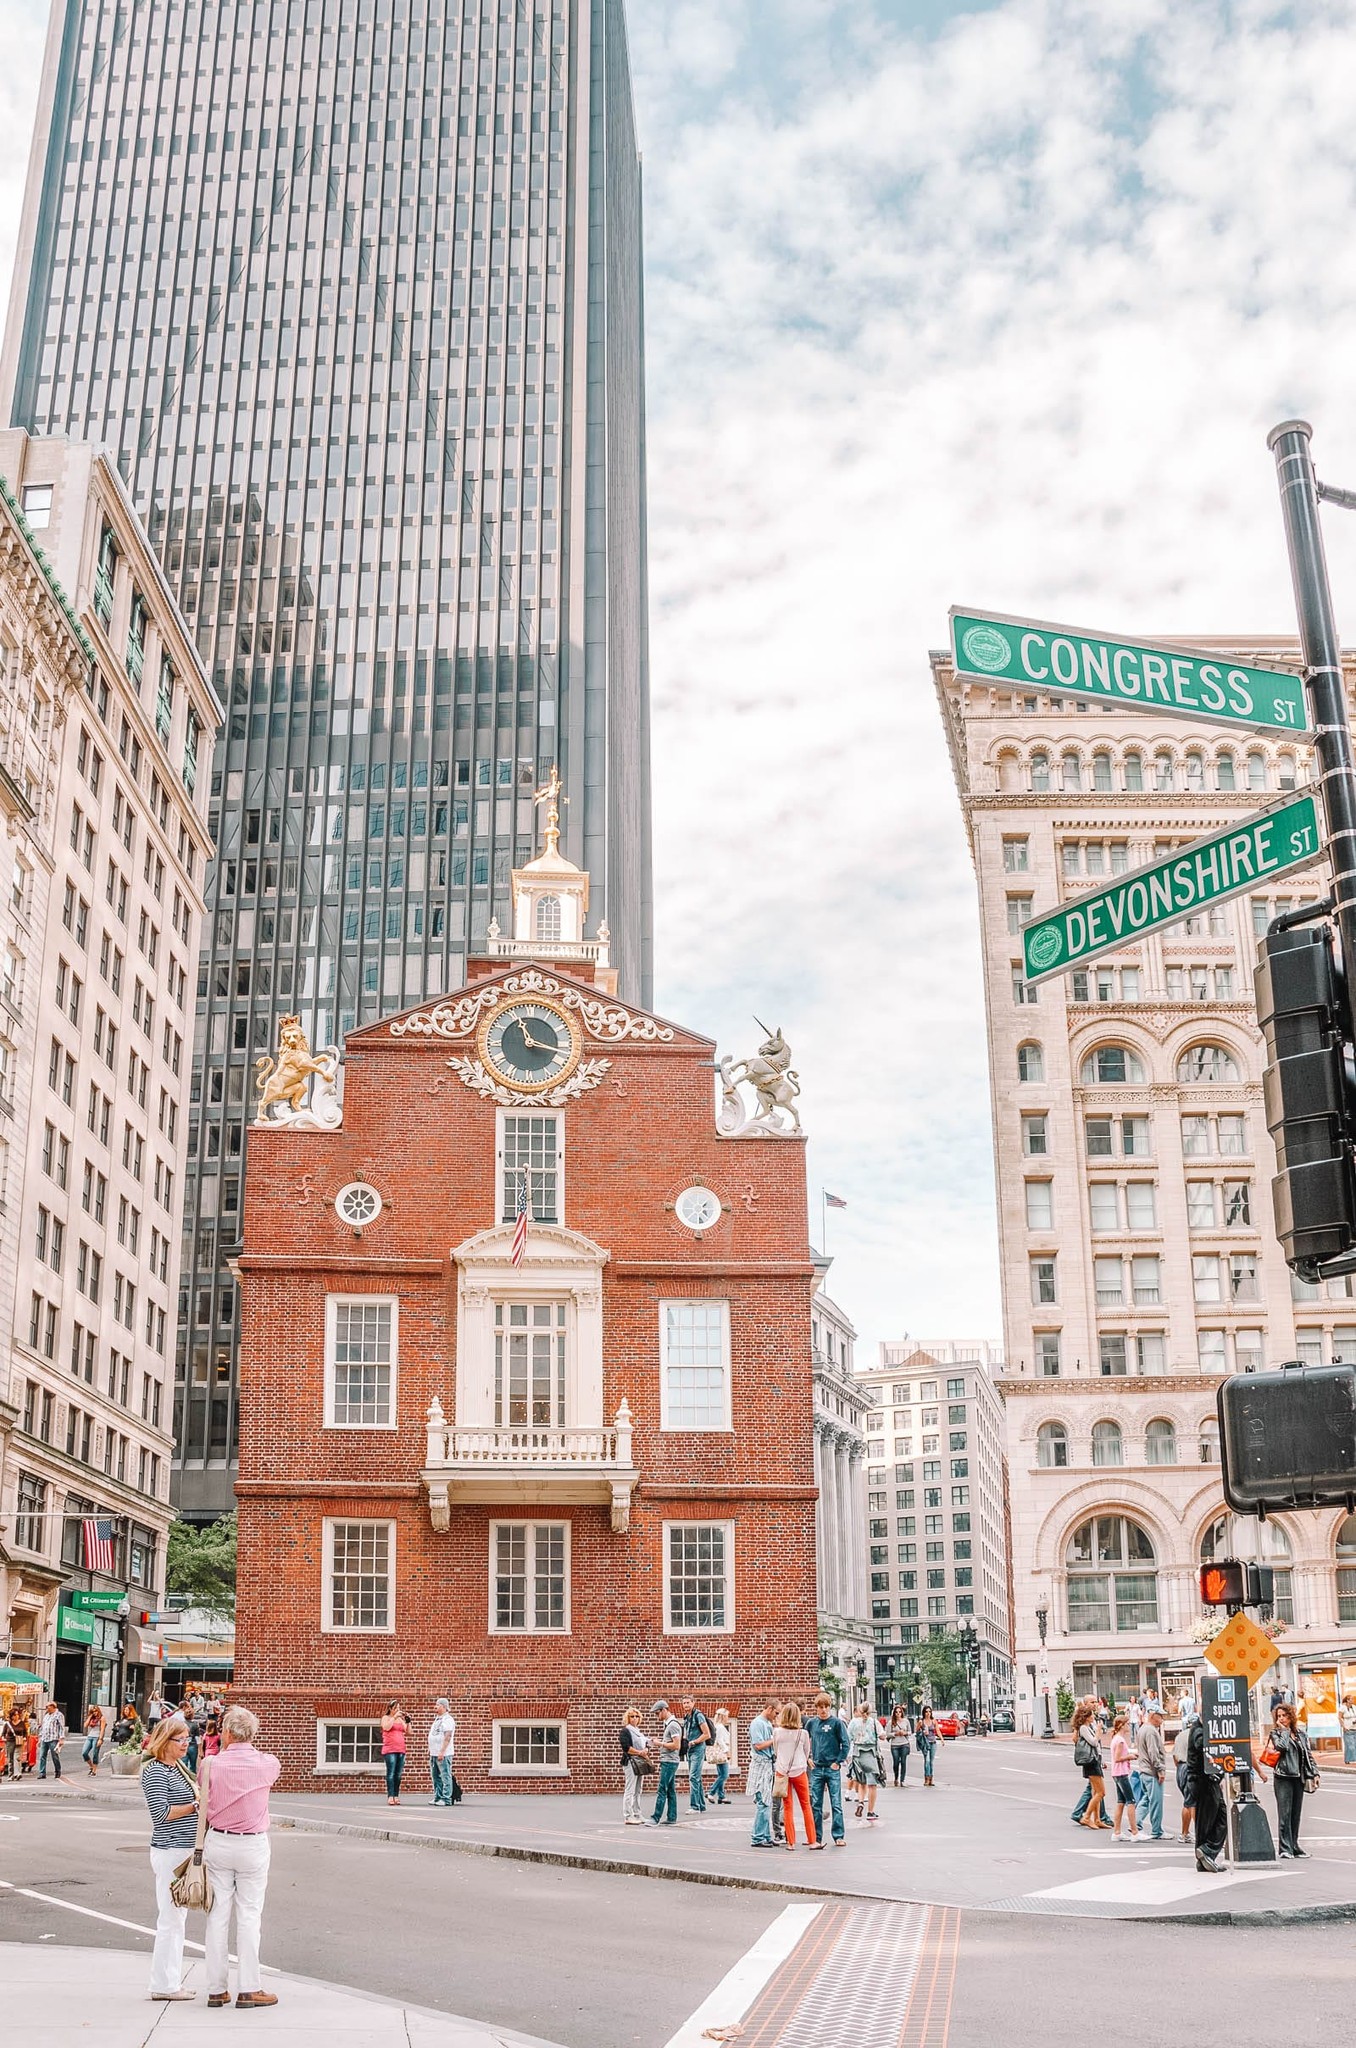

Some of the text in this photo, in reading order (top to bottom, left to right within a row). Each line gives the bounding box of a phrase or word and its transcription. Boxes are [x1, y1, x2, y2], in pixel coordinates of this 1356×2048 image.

[1020, 632, 1254, 716] CONGRESS
[1273, 698, 1297, 724] ST
[1065, 820, 1279, 957] DEVONSHIRE
[1290, 826, 1312, 857] ST
[1220, 1682, 1232, 1699] P
[1212, 1702, 1242, 1718] special
[1207, 1719, 1237, 1739] 14.00
